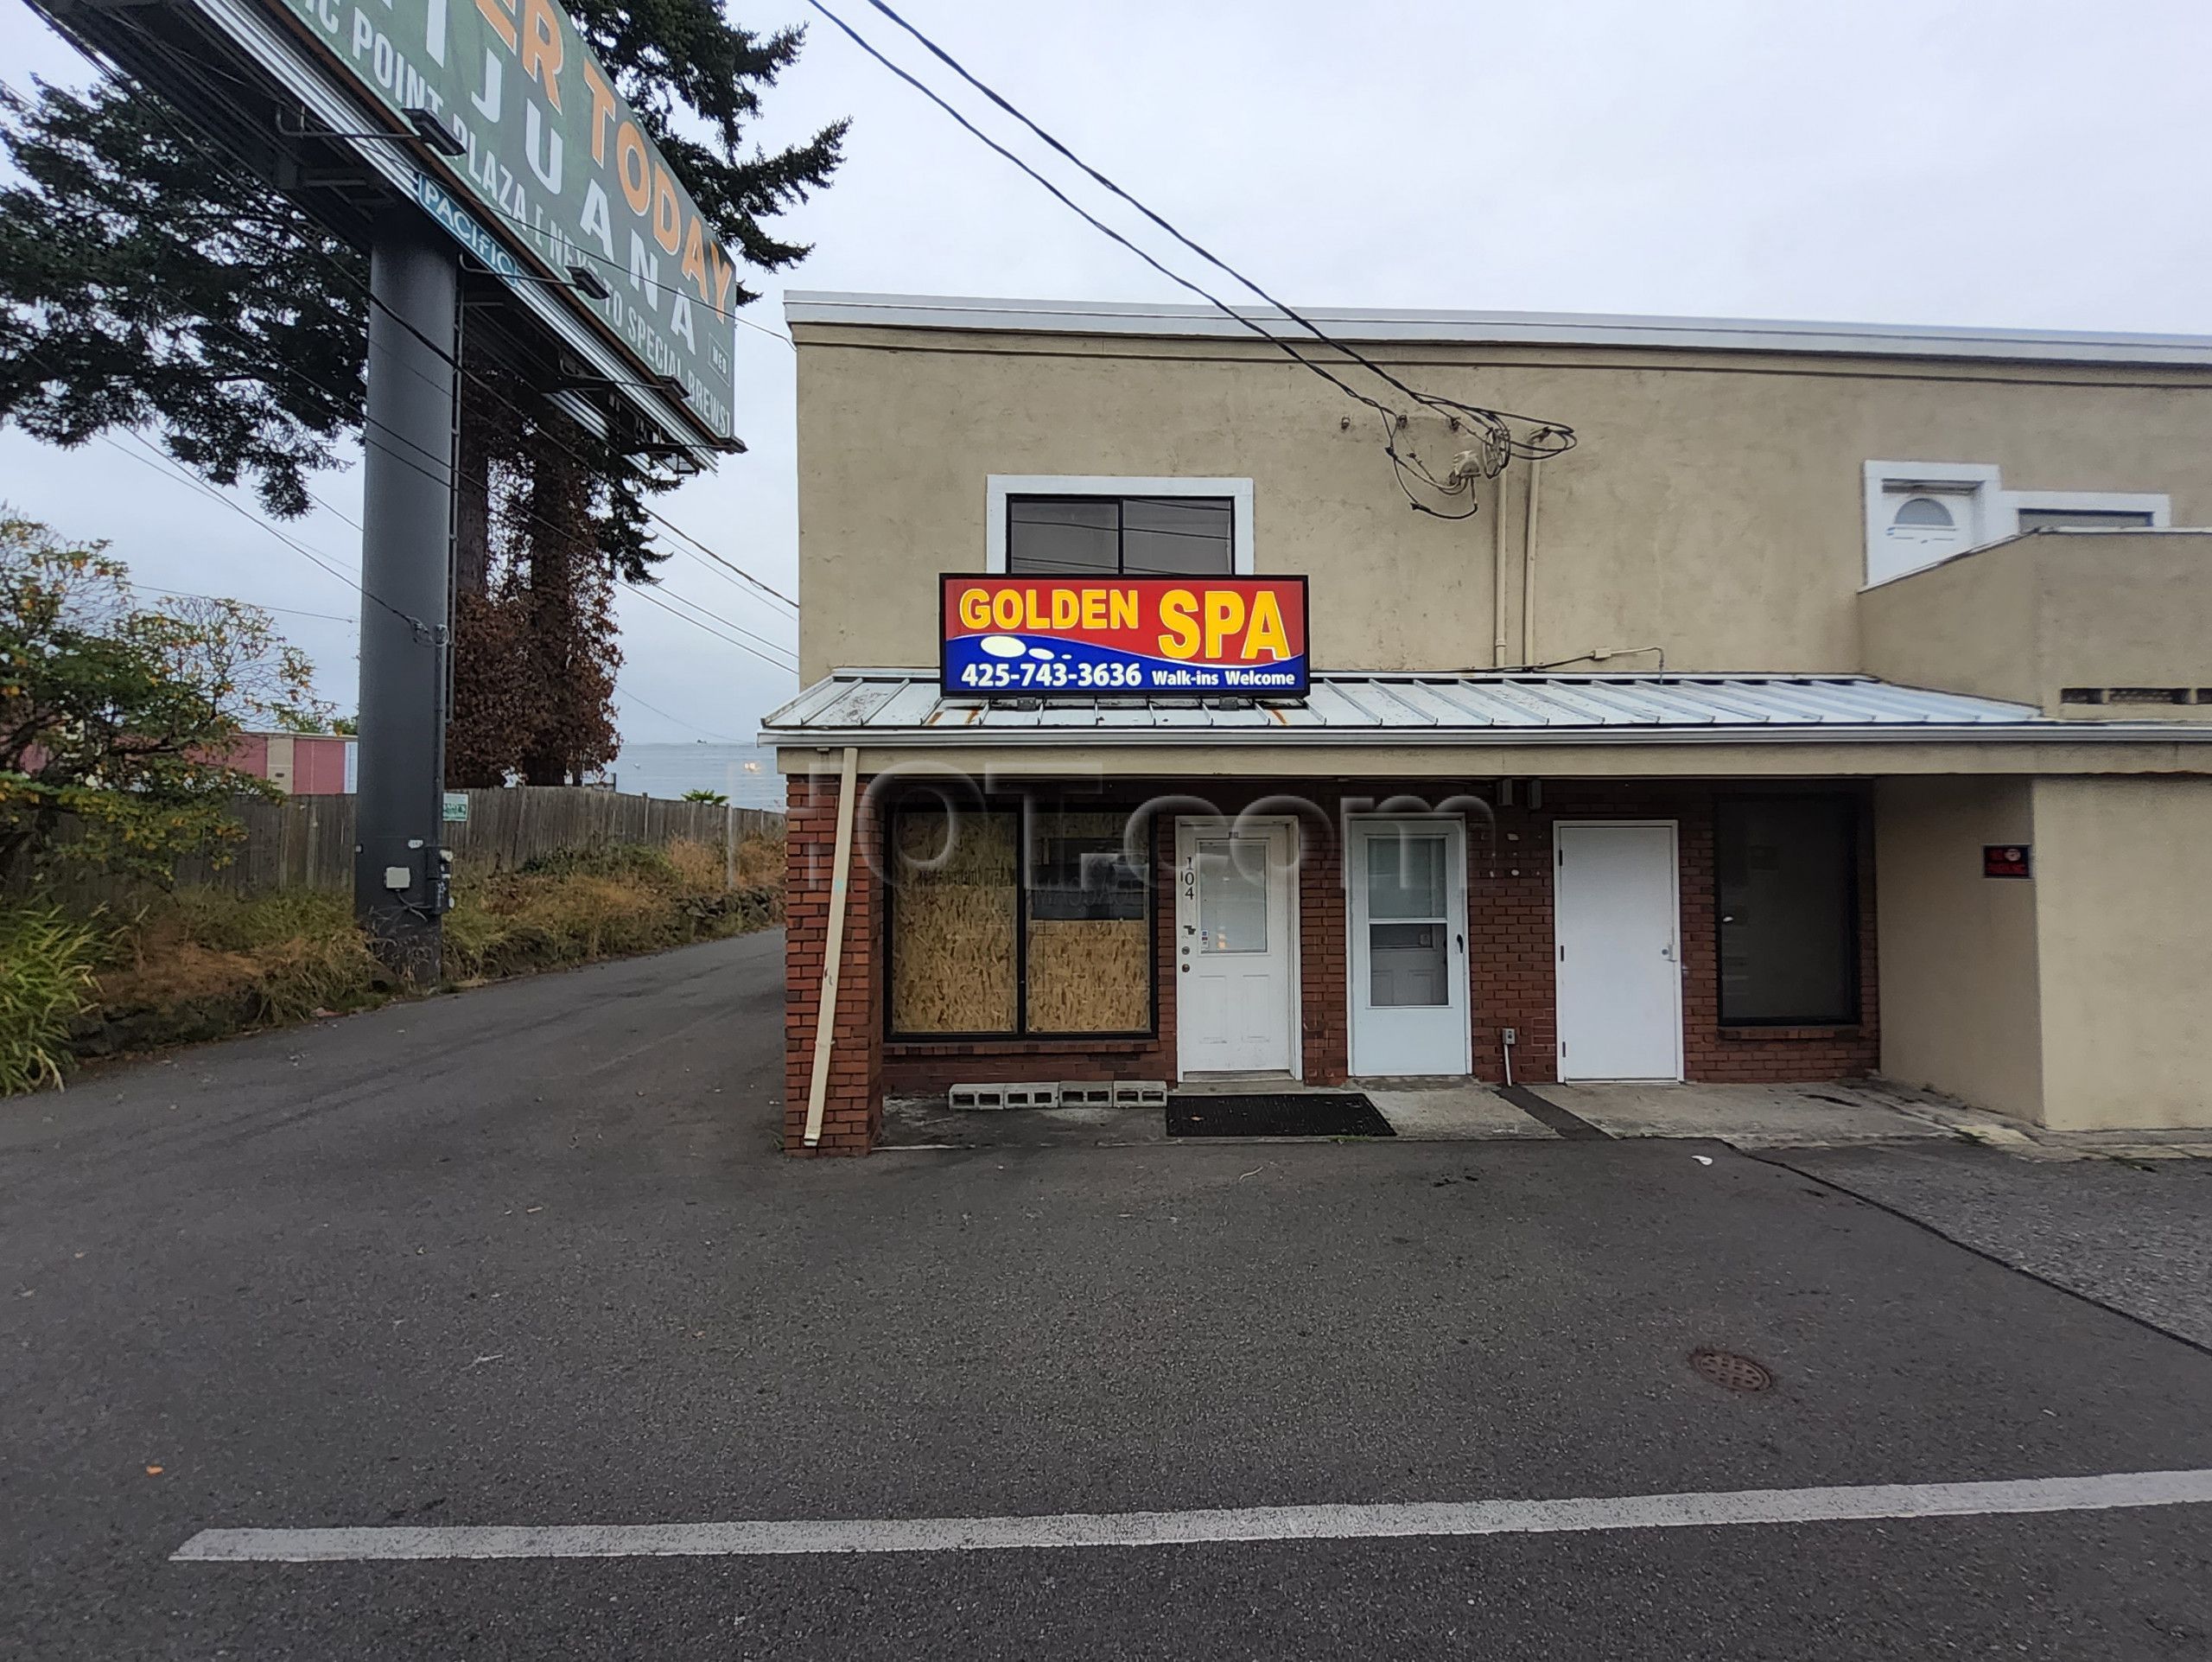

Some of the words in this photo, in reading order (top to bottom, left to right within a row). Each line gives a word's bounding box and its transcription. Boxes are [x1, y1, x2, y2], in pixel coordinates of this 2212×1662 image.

[353, 7, 444, 114] POINT
[453, 113, 527, 232] PLAZA
[379, 0, 696, 356] IJUANA
[584, 57, 733, 325] TODAY
[424, 182, 513, 278] PACIFIC
[959, 588, 1139, 630] GOLDEN
[1158, 589, 1292, 661] SPA
[961, 662, 1142, 687] 425-743-3636
[1152, 669, 1219, 685] Walk-ins
[1224, 670, 1295, 685] Welcome
[1184, 856, 1195, 901] 104
